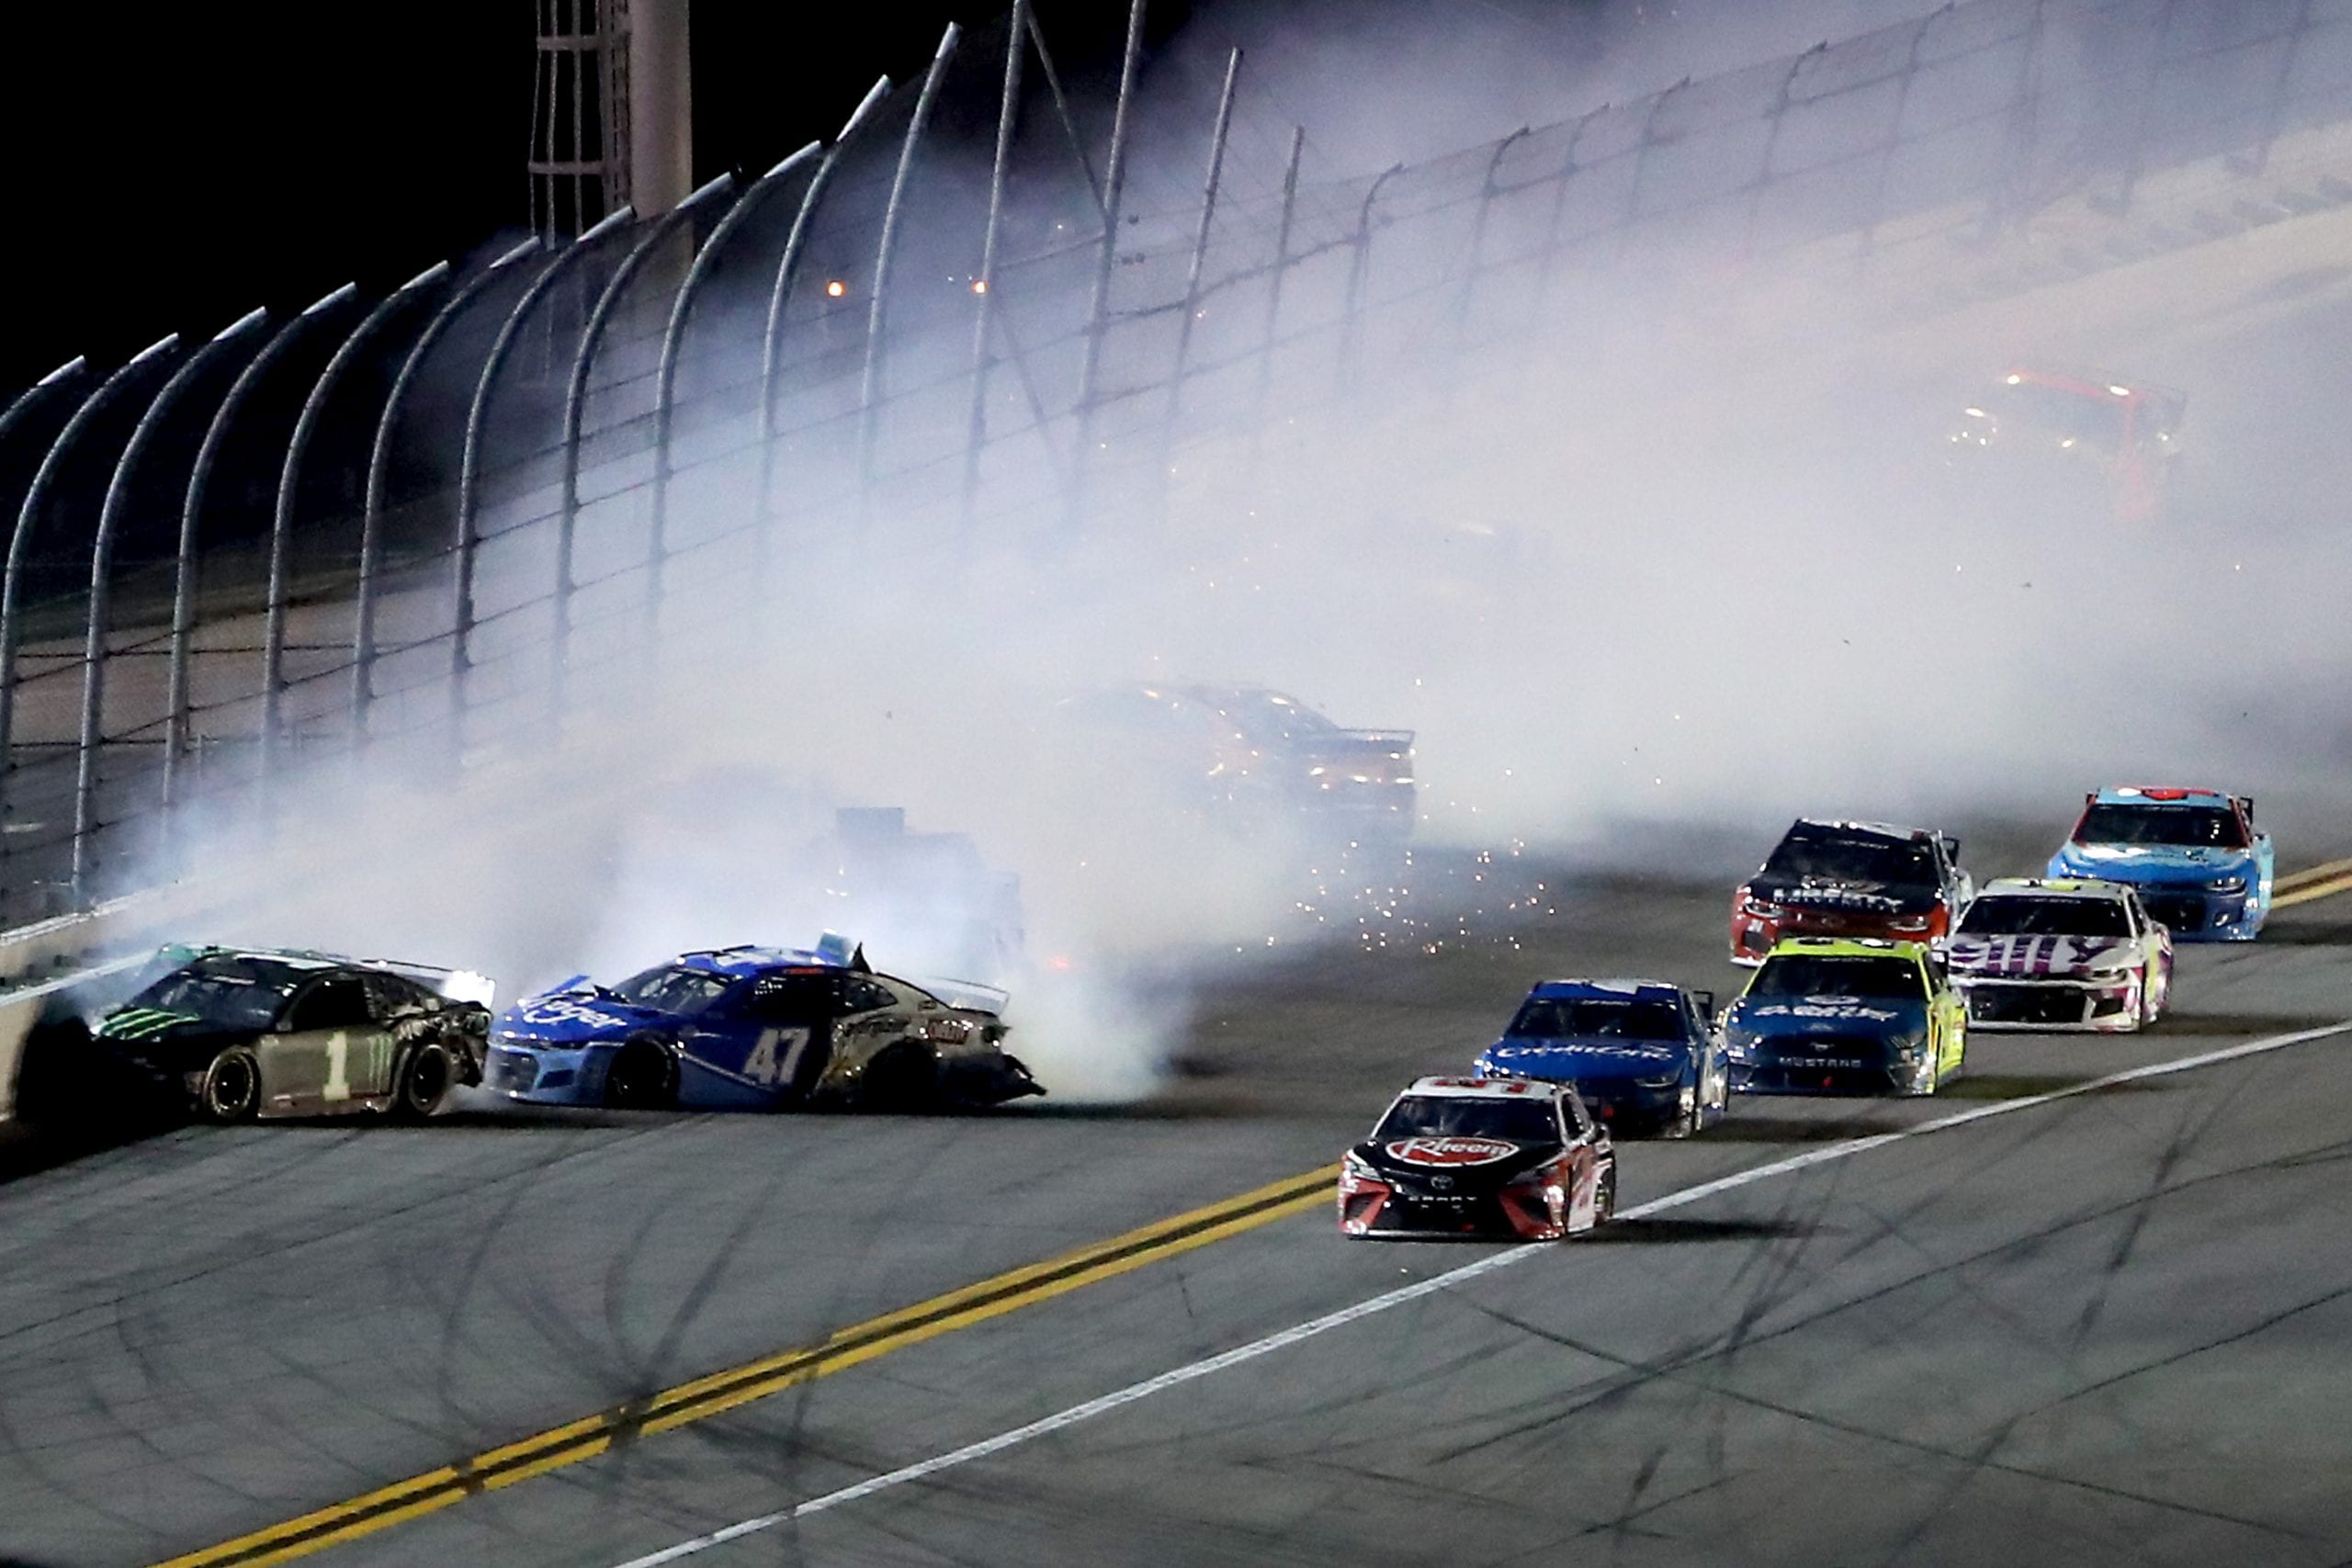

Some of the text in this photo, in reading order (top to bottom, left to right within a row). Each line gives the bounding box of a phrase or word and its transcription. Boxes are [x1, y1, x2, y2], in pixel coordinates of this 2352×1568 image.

[322, 1031, 350, 1101] 1
[743, 1026, 810, 1084] 47
[1779, 1057, 1861, 1068] MUSTANG
[1400, 1137, 1510, 1157] Rheem
